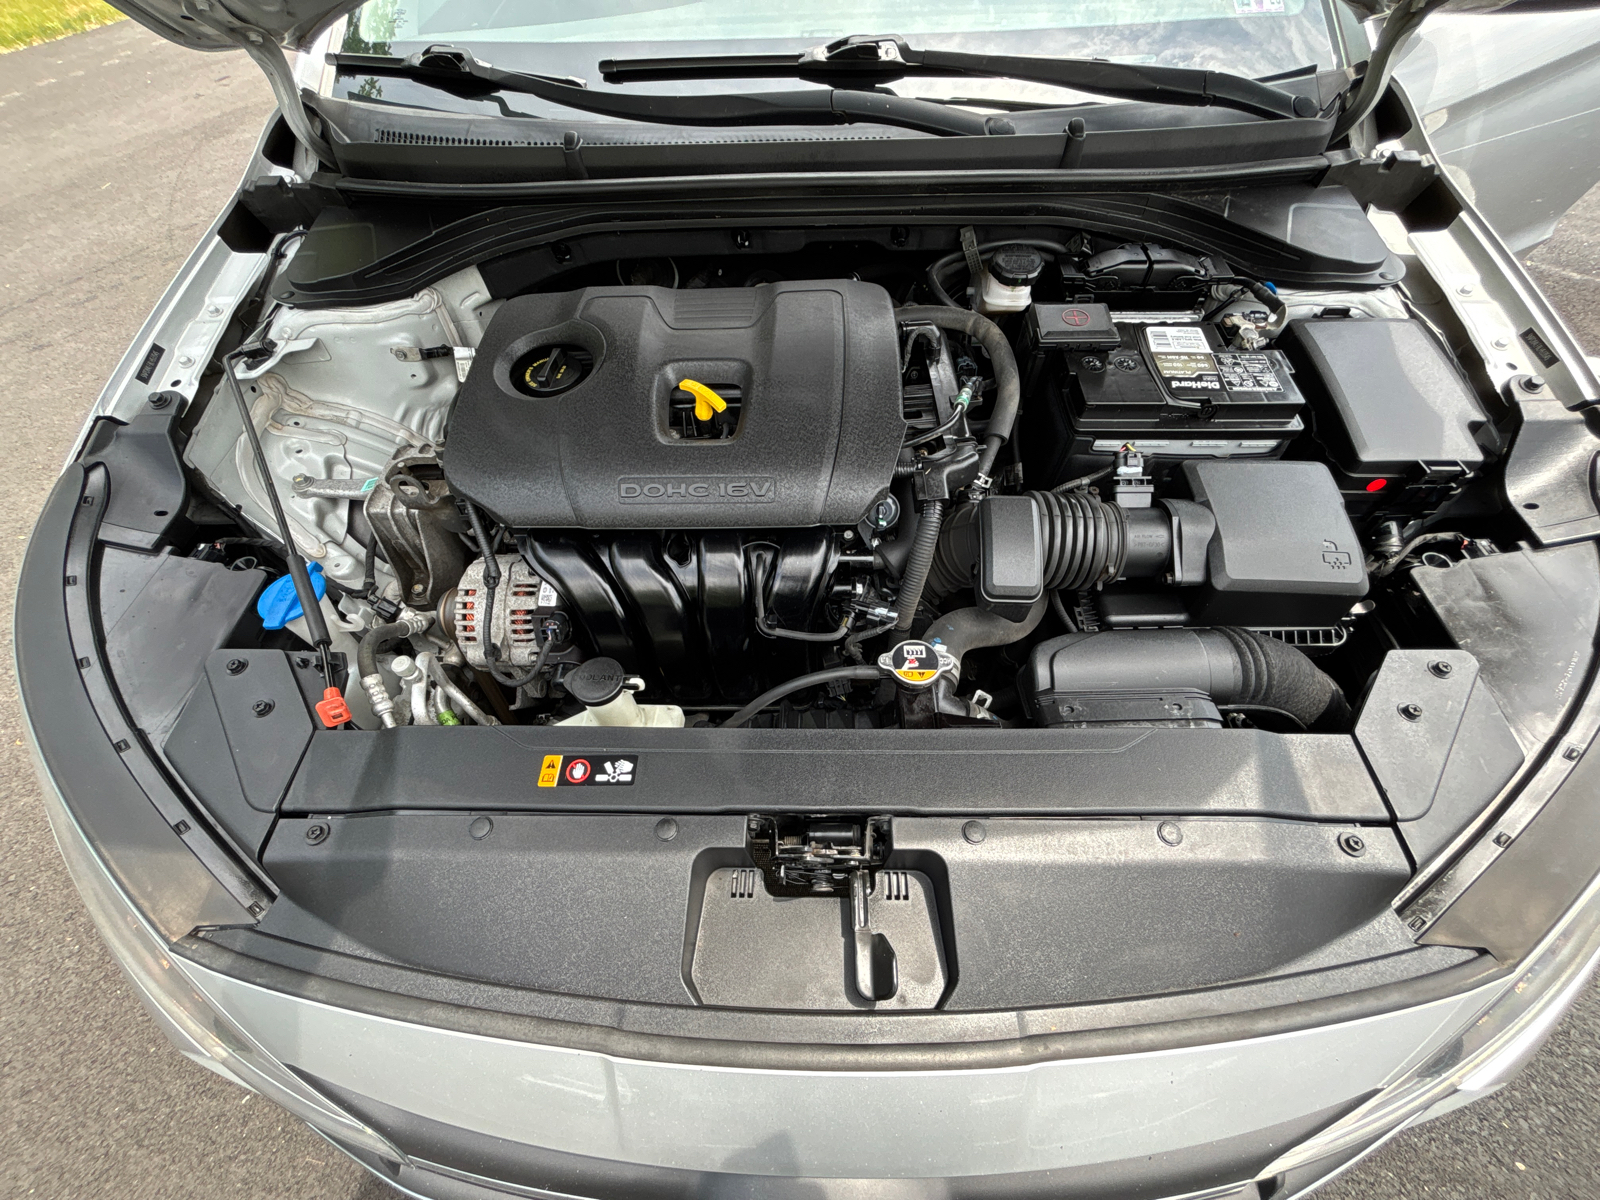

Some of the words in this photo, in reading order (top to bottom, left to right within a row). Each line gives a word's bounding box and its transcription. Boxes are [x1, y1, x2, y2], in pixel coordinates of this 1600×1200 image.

[1171, 380, 1220, 390] DieHard
[620, 483, 710, 498] DOHC
[718, 482, 772, 497] 16V
